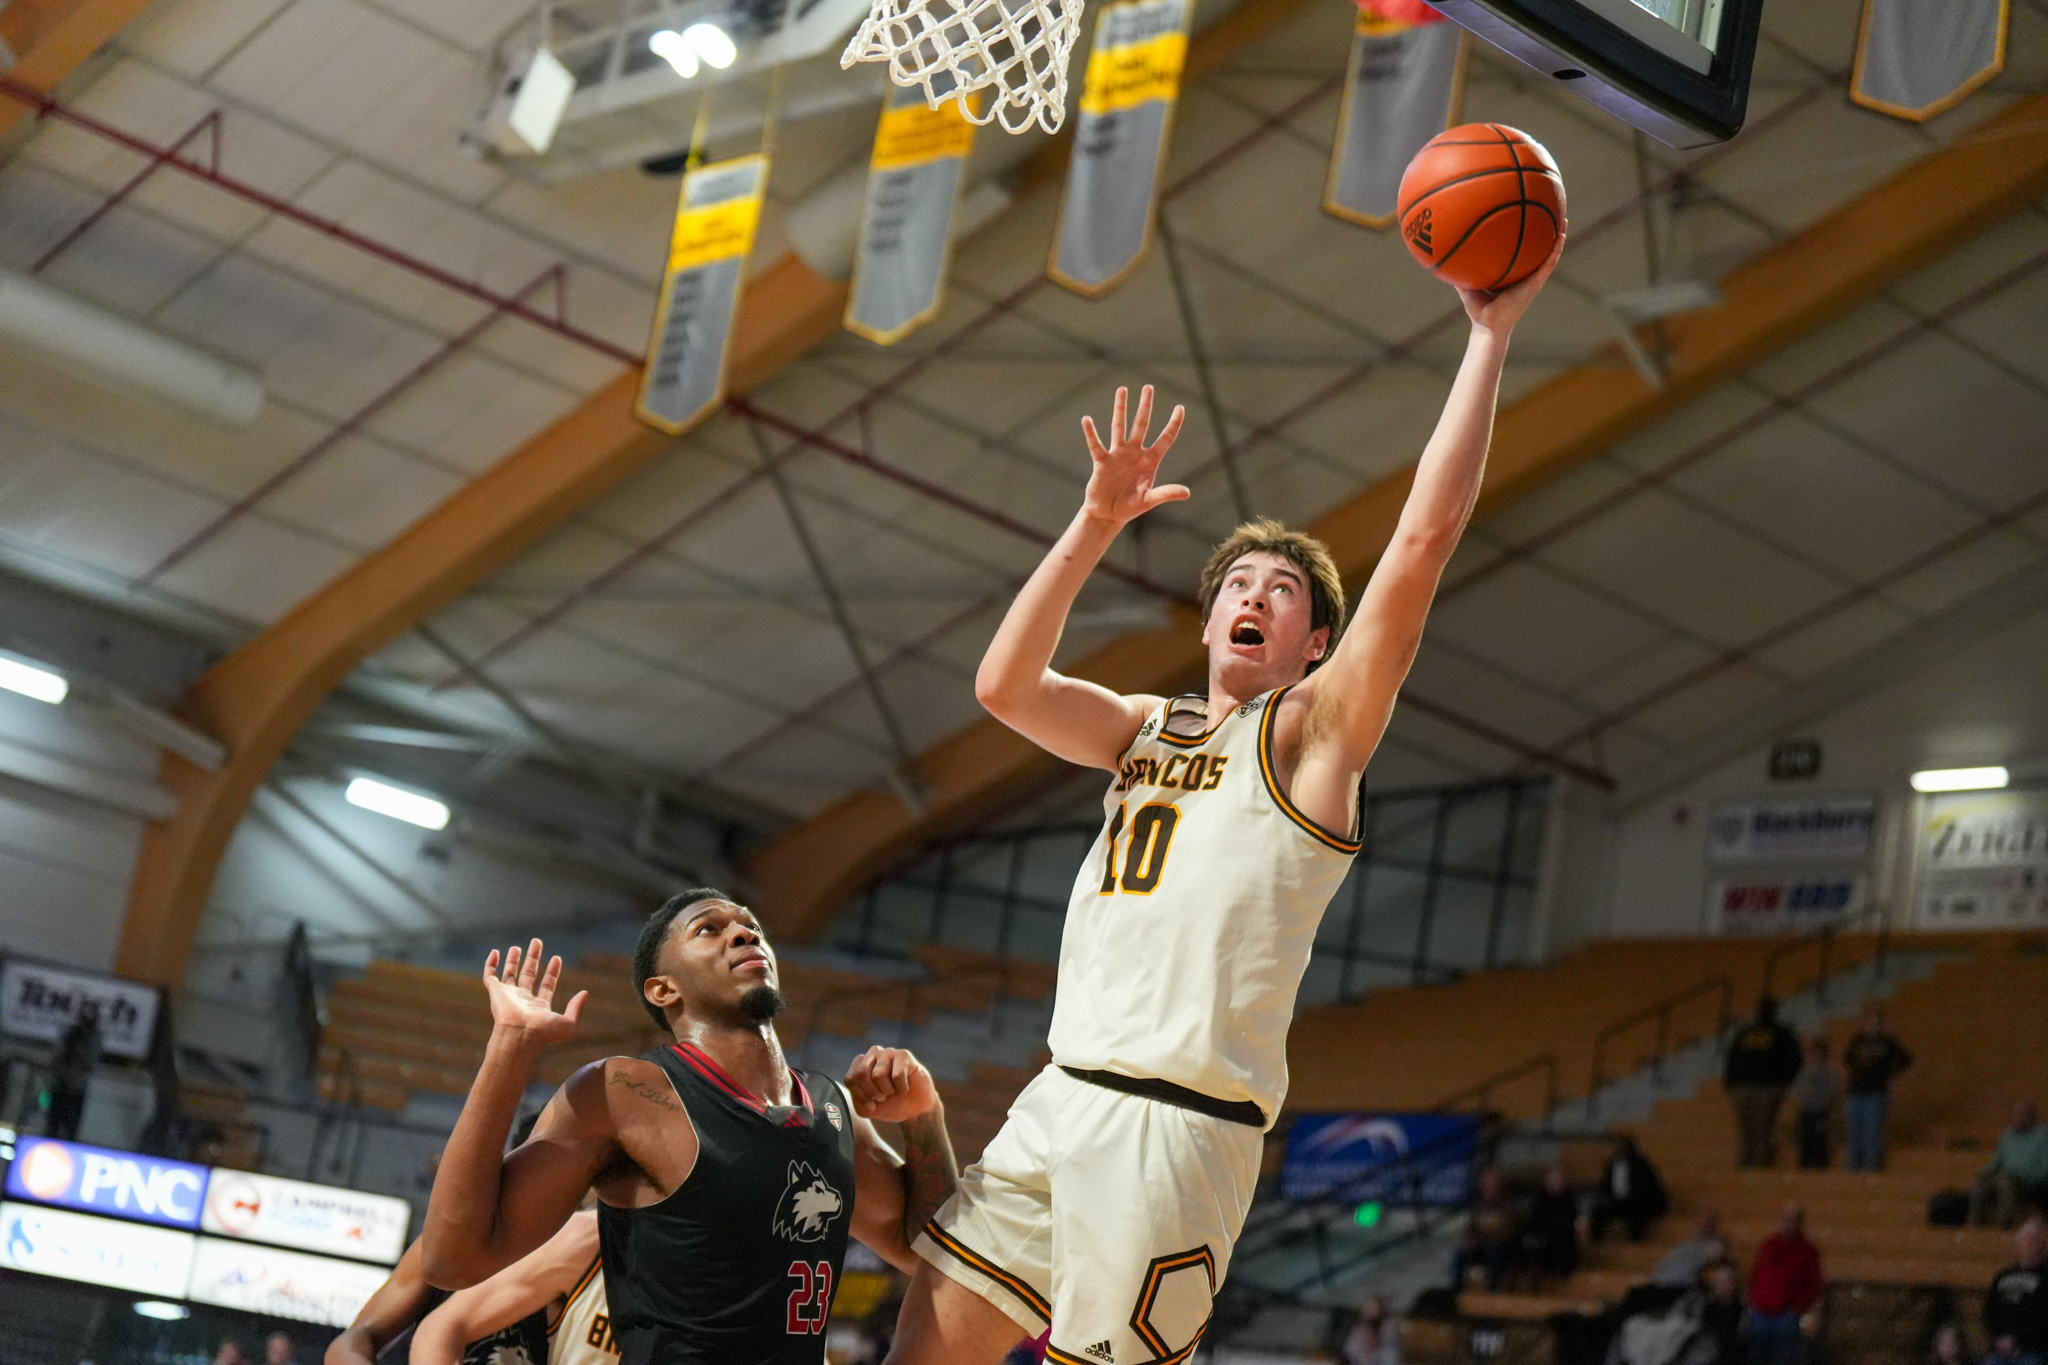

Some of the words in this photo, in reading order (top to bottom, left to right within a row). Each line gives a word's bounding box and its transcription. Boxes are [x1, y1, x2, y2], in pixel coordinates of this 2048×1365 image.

[1404, 207, 1432, 239] adidas
[1099, 800, 1182, 896] 10
[79, 1152, 201, 1222] PNC
[786, 1260, 833, 1335] 23
[1085, 1347, 1115, 1364] adidas
